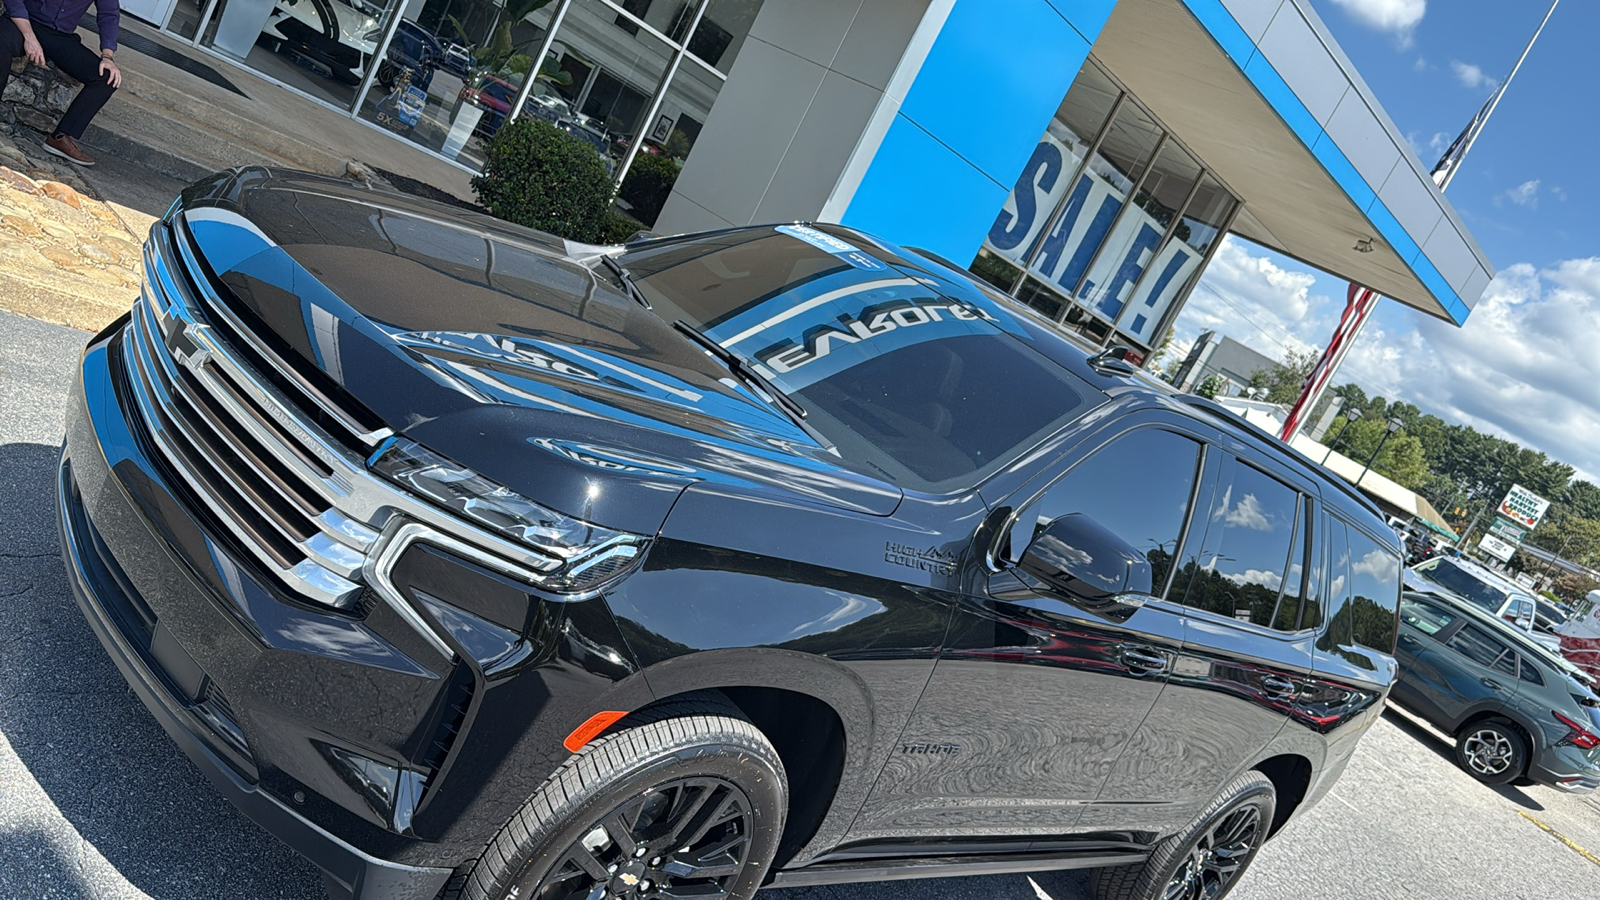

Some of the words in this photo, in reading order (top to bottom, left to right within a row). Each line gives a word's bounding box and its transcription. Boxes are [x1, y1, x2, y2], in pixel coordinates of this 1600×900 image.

[376, 112, 393, 125] 5X
[988, 141, 1190, 335] SALE!
[1509, 497, 1539, 514] HARVEST
[1510, 491, 1538, 507] HEALTHY
[1508, 503, 1539, 521] PRODUCE
[885, 541, 923, 559] HIGH
[884, 552, 956, 577] COUNTRY
